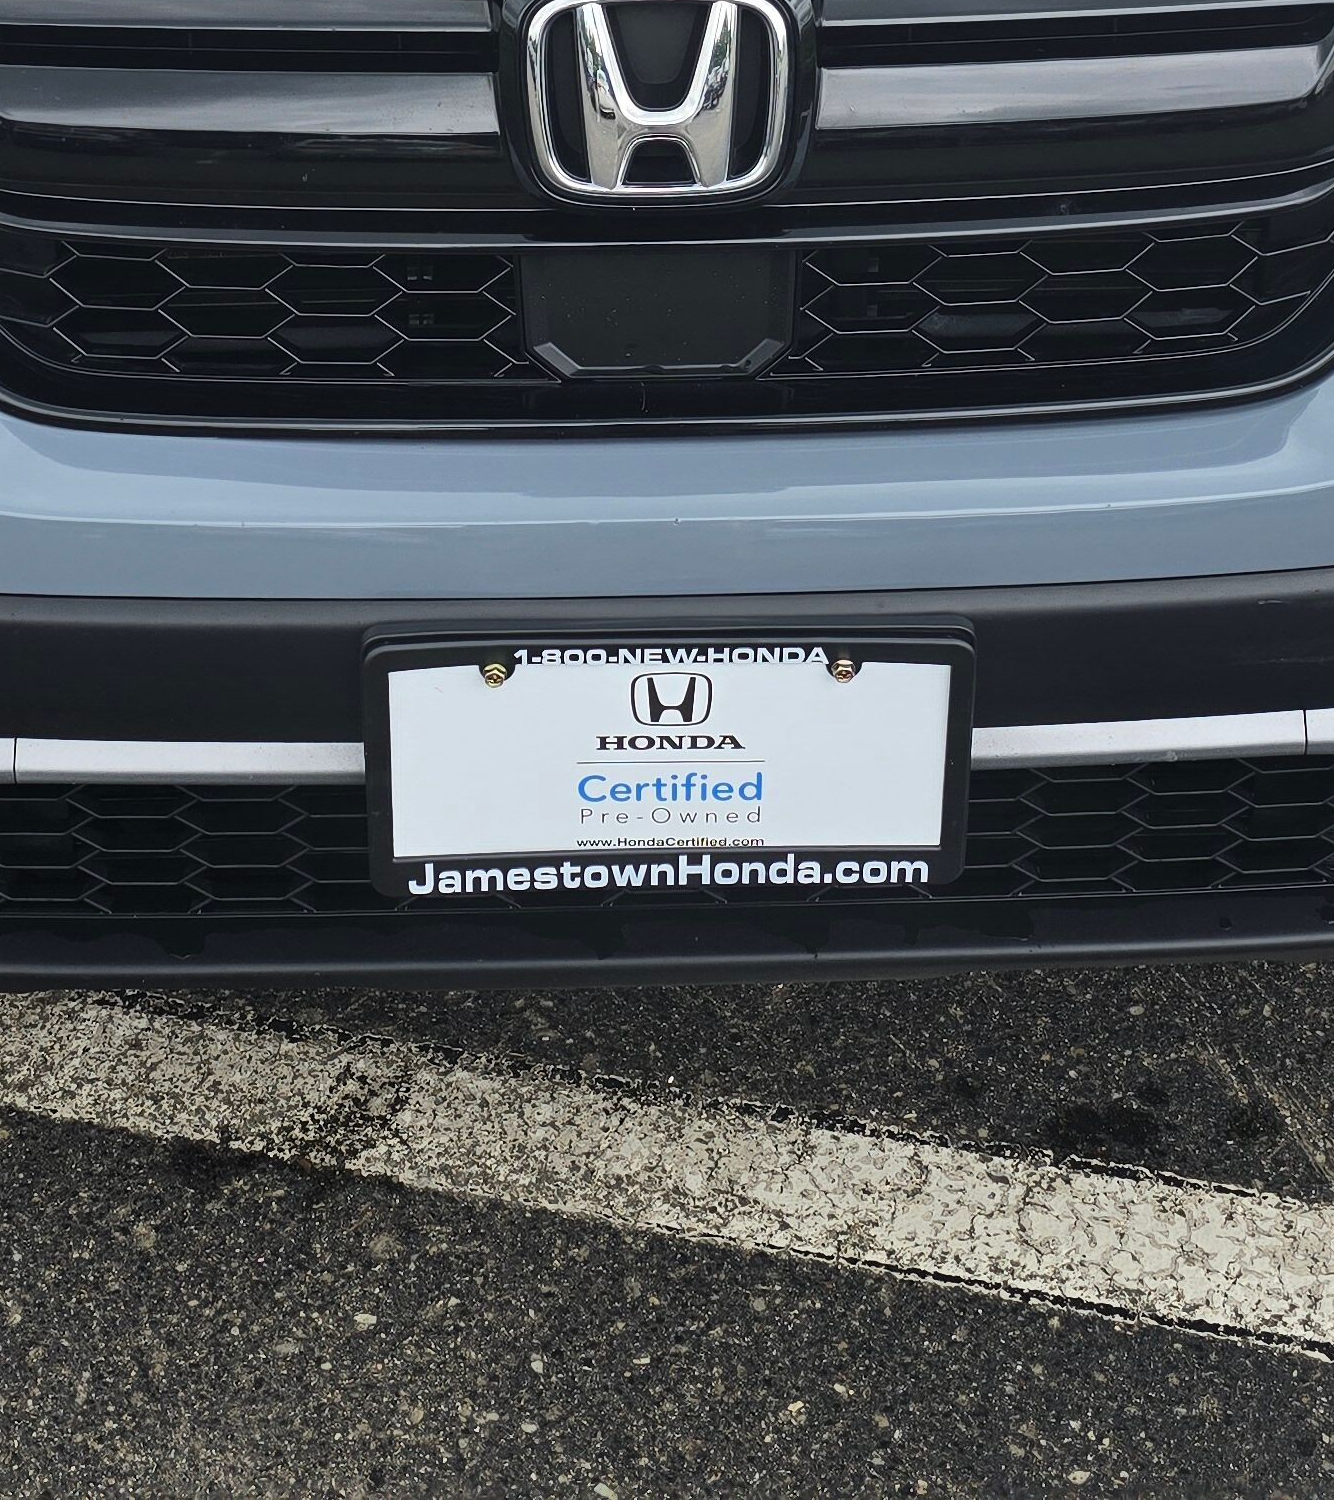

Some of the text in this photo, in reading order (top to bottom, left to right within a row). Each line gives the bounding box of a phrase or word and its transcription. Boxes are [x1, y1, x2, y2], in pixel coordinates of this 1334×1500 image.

[513, 647, 829, 666] 1-800-NEW-HONDA
[596, 735, 745, 750] HONDA
[577, 772, 764, 802] Certified
[579, 807, 762, 825] Pre-Owned
[576, 836, 765, 847] www.HondaCertified.com
[408, 853, 929, 895] JamestownHonda.com
